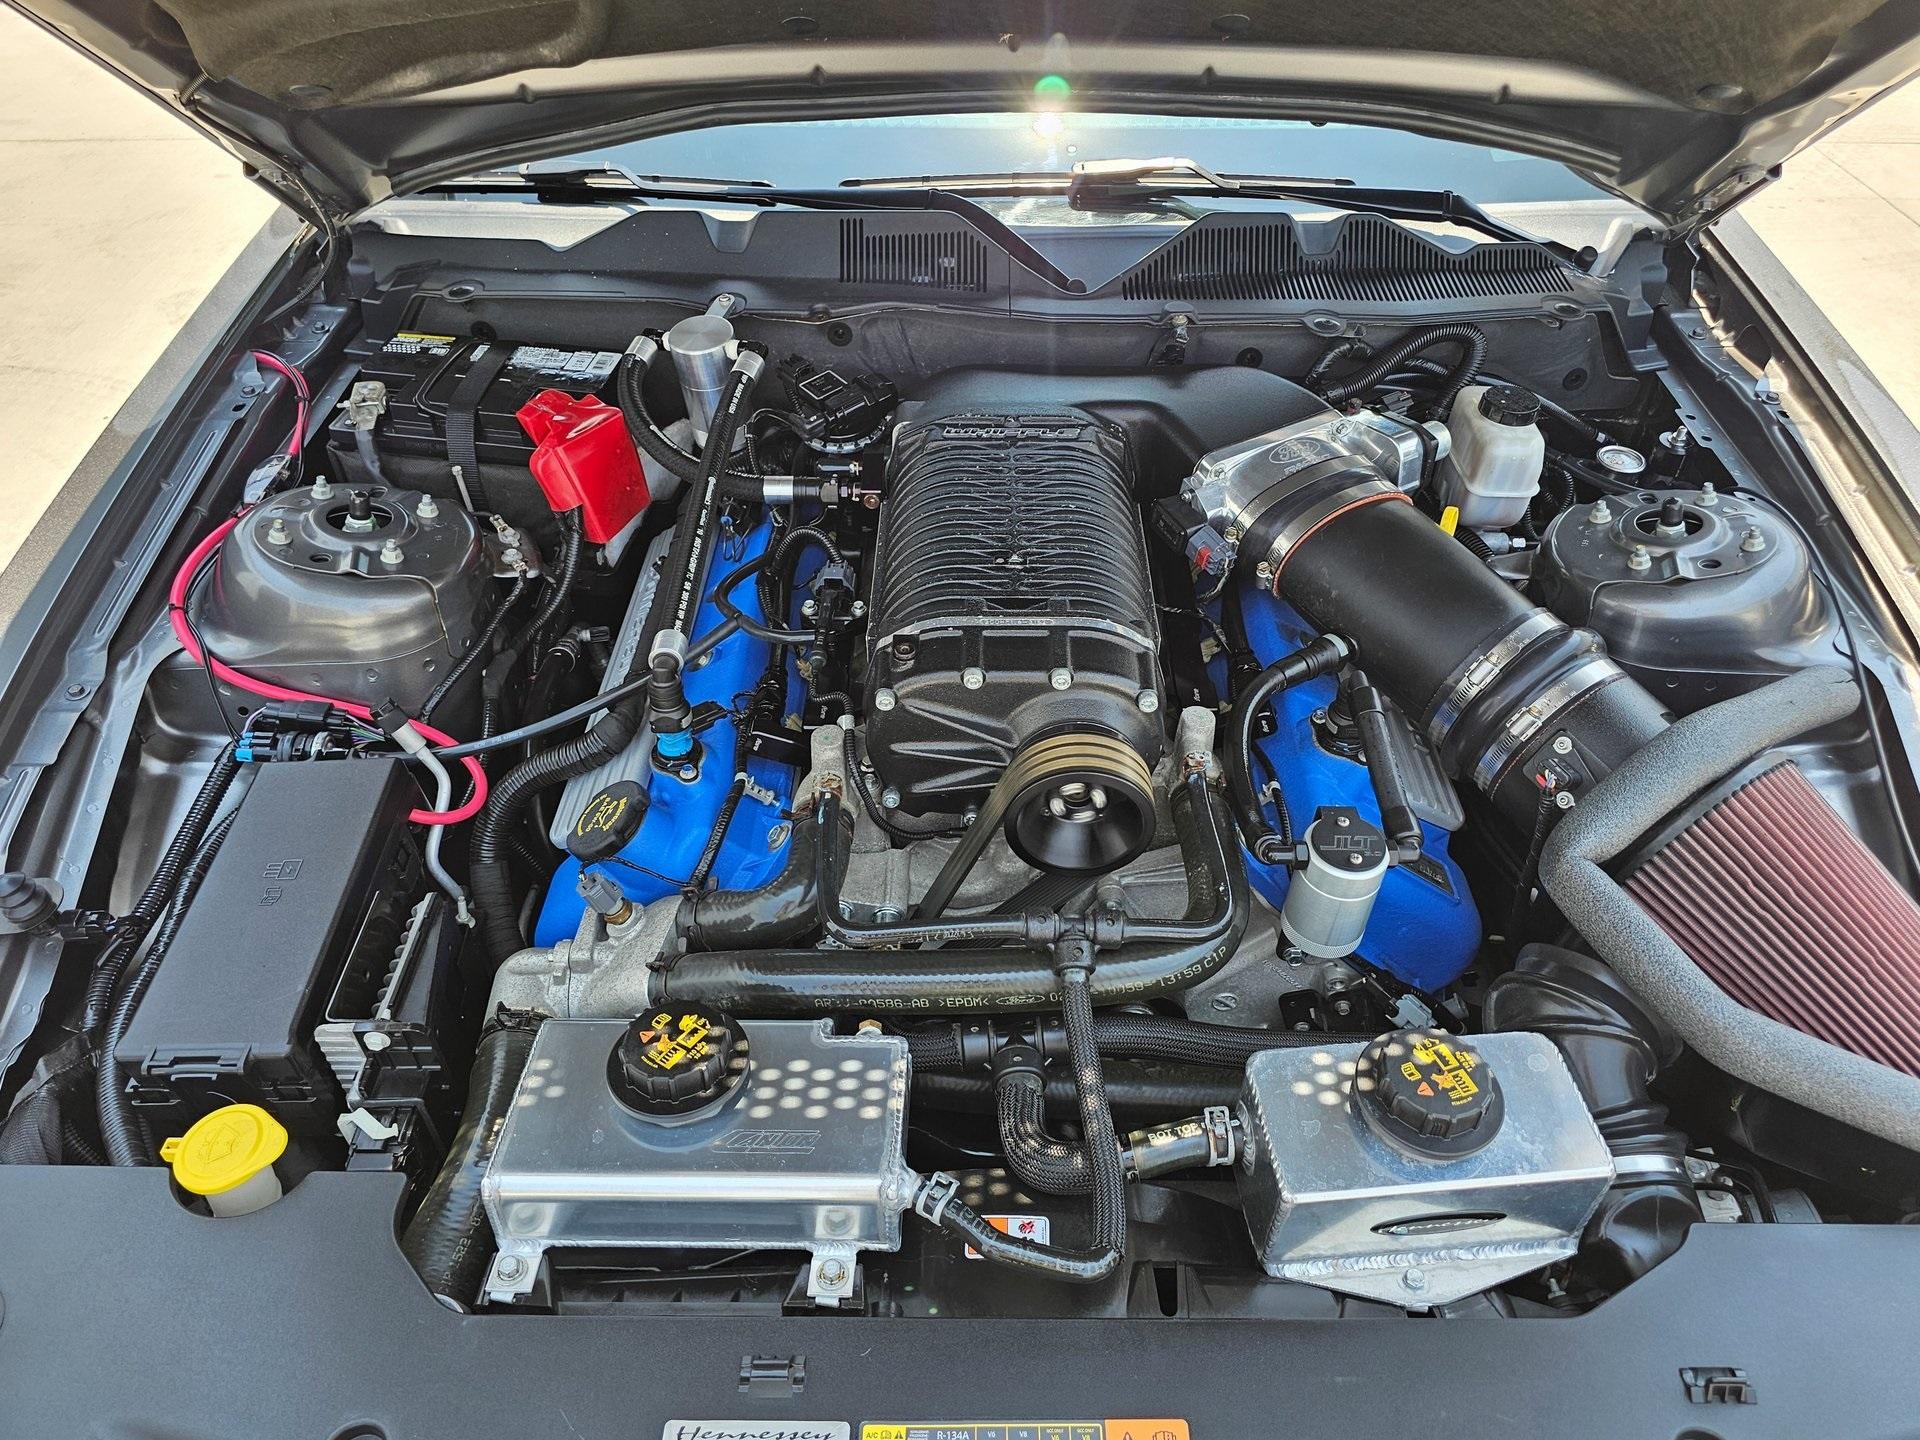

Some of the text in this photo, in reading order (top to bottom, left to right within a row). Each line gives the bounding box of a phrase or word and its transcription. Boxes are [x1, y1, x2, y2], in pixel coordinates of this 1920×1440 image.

[734, 382, 745, 399] MADE
[728, 402, 738, 414] USA
[1319, 835, 1378, 850] JLT
